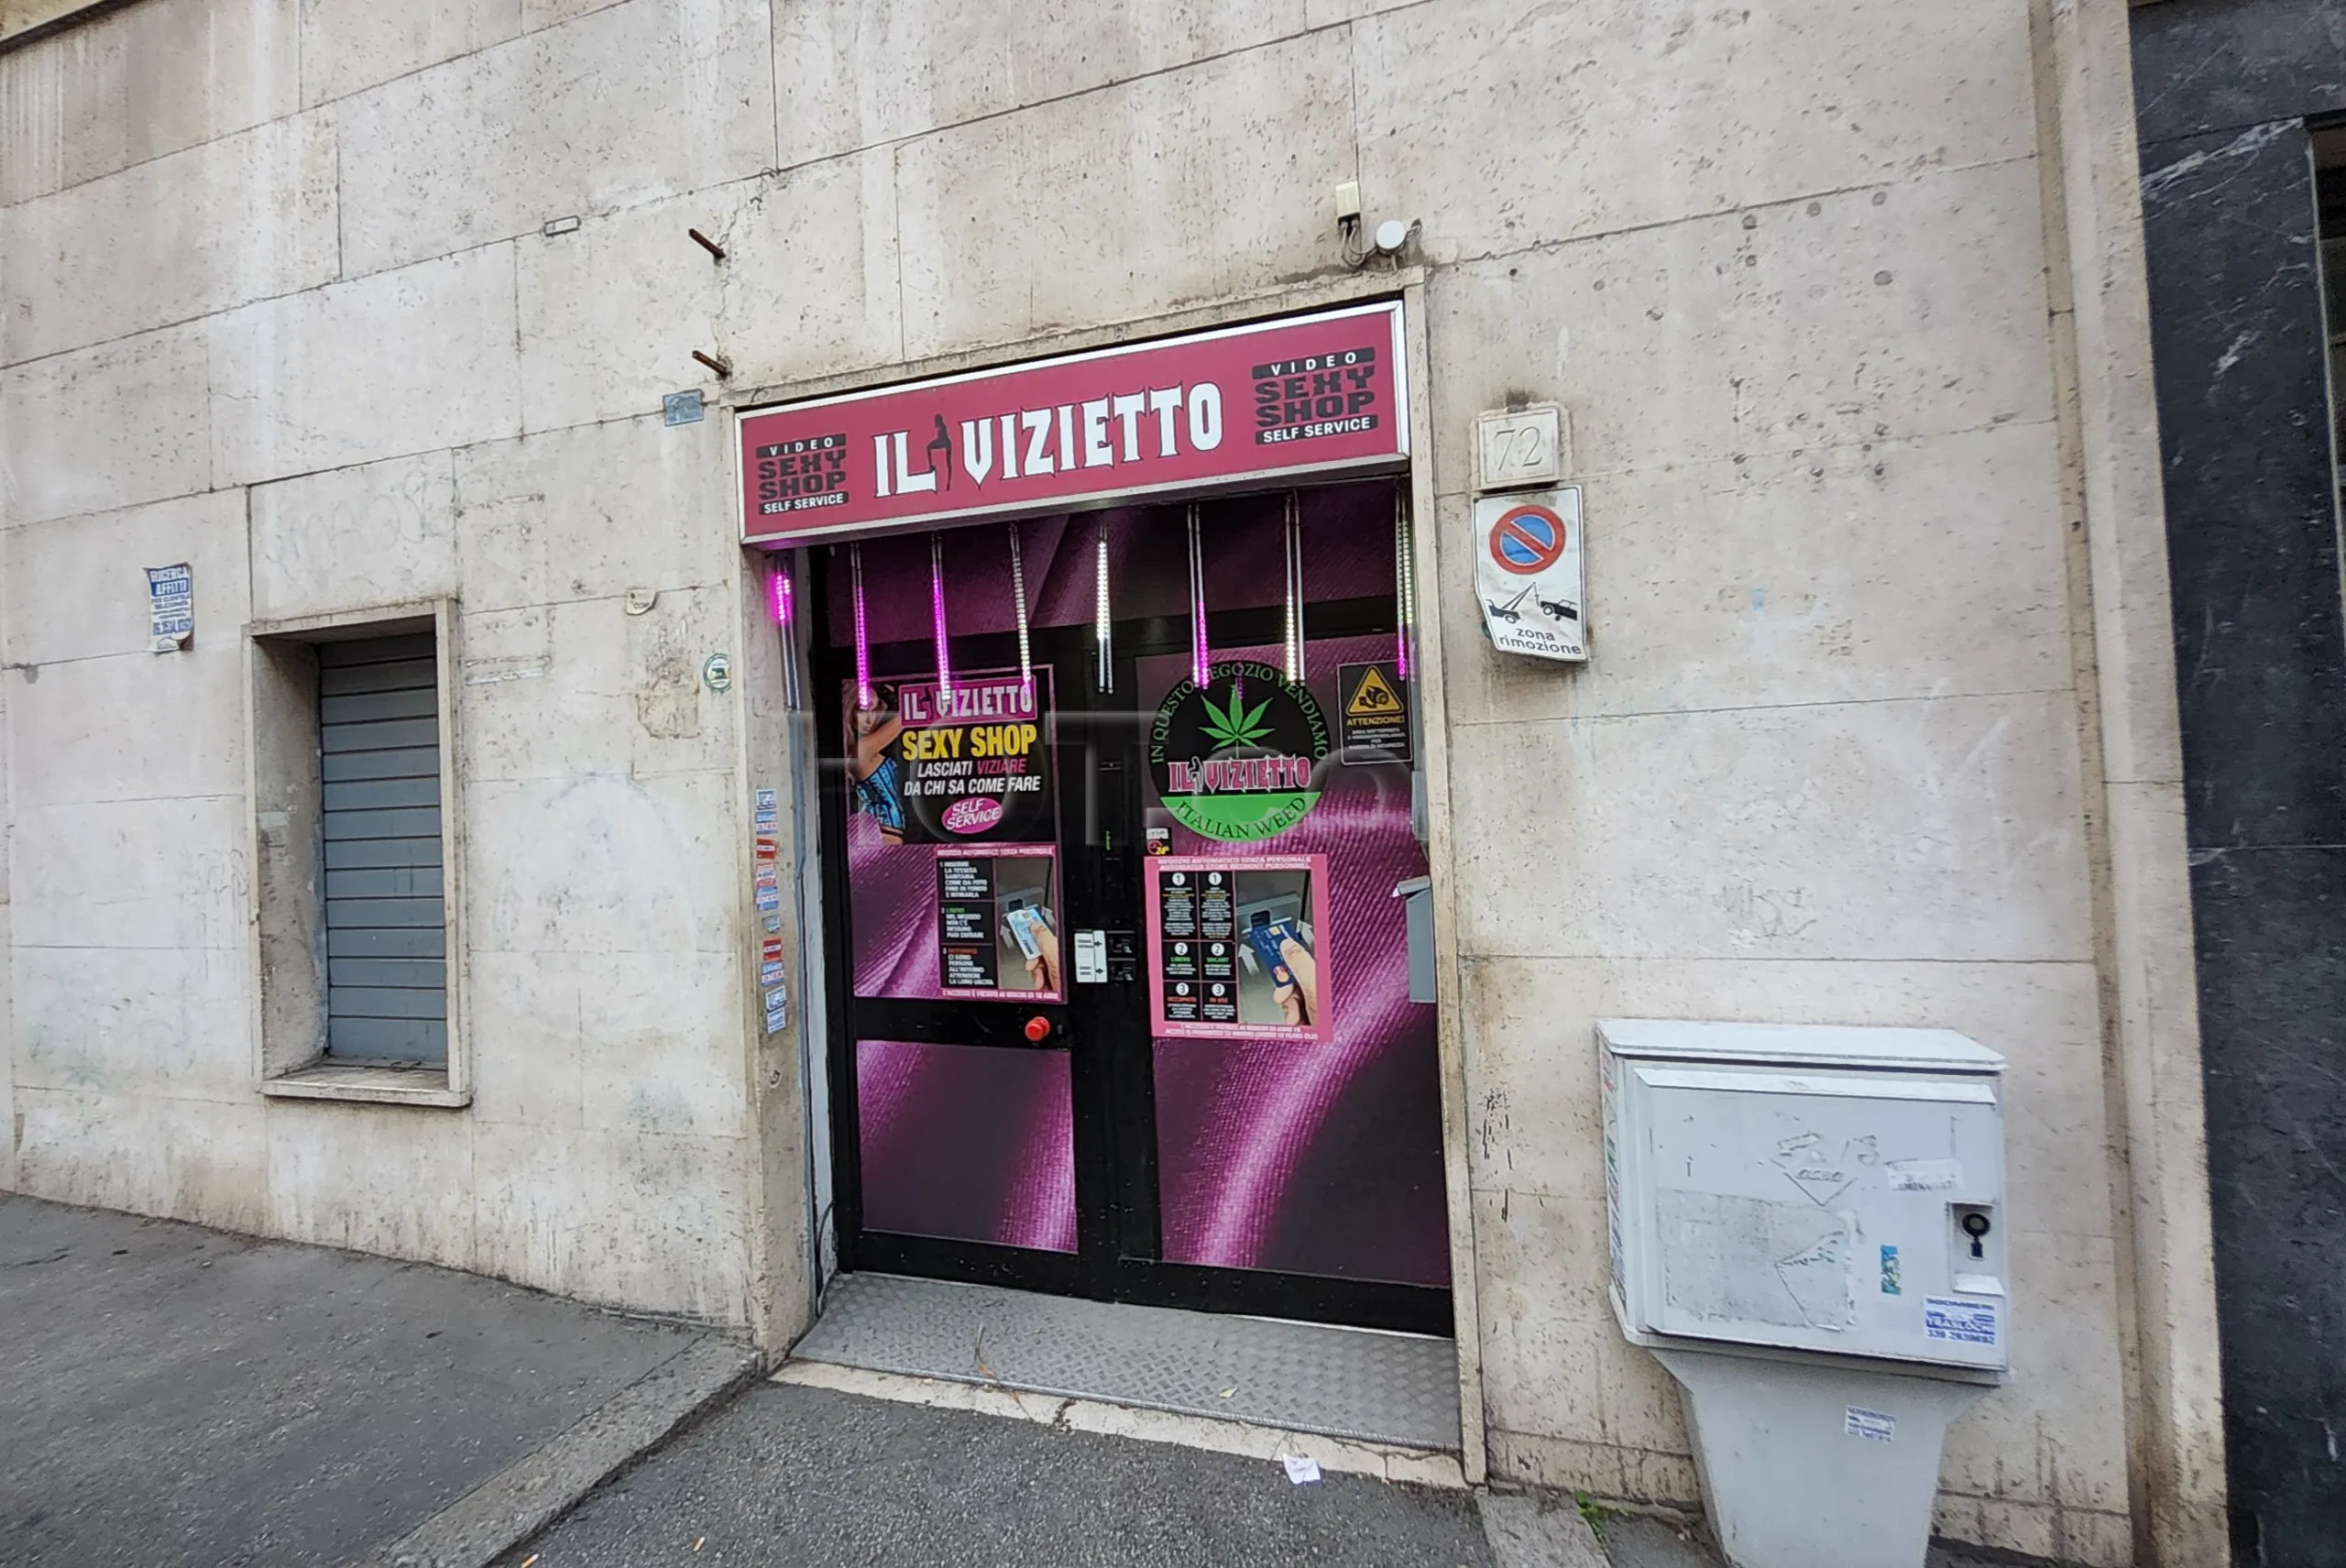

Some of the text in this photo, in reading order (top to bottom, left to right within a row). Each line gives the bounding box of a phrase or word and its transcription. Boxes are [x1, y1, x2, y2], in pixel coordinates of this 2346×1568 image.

[1271, 352, 1356, 377] VIDEO
[1255, 366, 1375, 404] SEXY
[1255, 391, 1375, 427] SHOP
[872, 380, 1224, 498] IL VIZIETTO
[1263, 417, 1371, 444] SELF SERVICE
[769, 437, 834, 456] VIDEO
[1494, 425, 1543, 472] 72
[759, 450, 846, 479] SEXY
[759, 471, 846, 501] SHOP
[763, 492, 844, 514] SELF SERVICE
[155, 579, 188, 595] AFFITTI
[1498, 633, 1582, 655] rimozione
[1516, 627, 1556, 641] zona
[1208, 662, 1274, 682] EGOZIO
[904, 692, 927, 720] IL
[1153, 680, 1194, 741] QUESTO
[902, 724, 1037, 762] SEXY SHOP
[1151, 744, 1165, 763] IN
[917, 758, 1026, 778] LASCIATI VIZIARE
[1168, 754, 1310, 795] IL VIZIETTO
[904, 775, 1041, 796] DA CHI SA COME FARE
[947, 799, 1001, 830] SELF SERVICE
[1176, 797, 1306, 839] ITALIAN WEED
